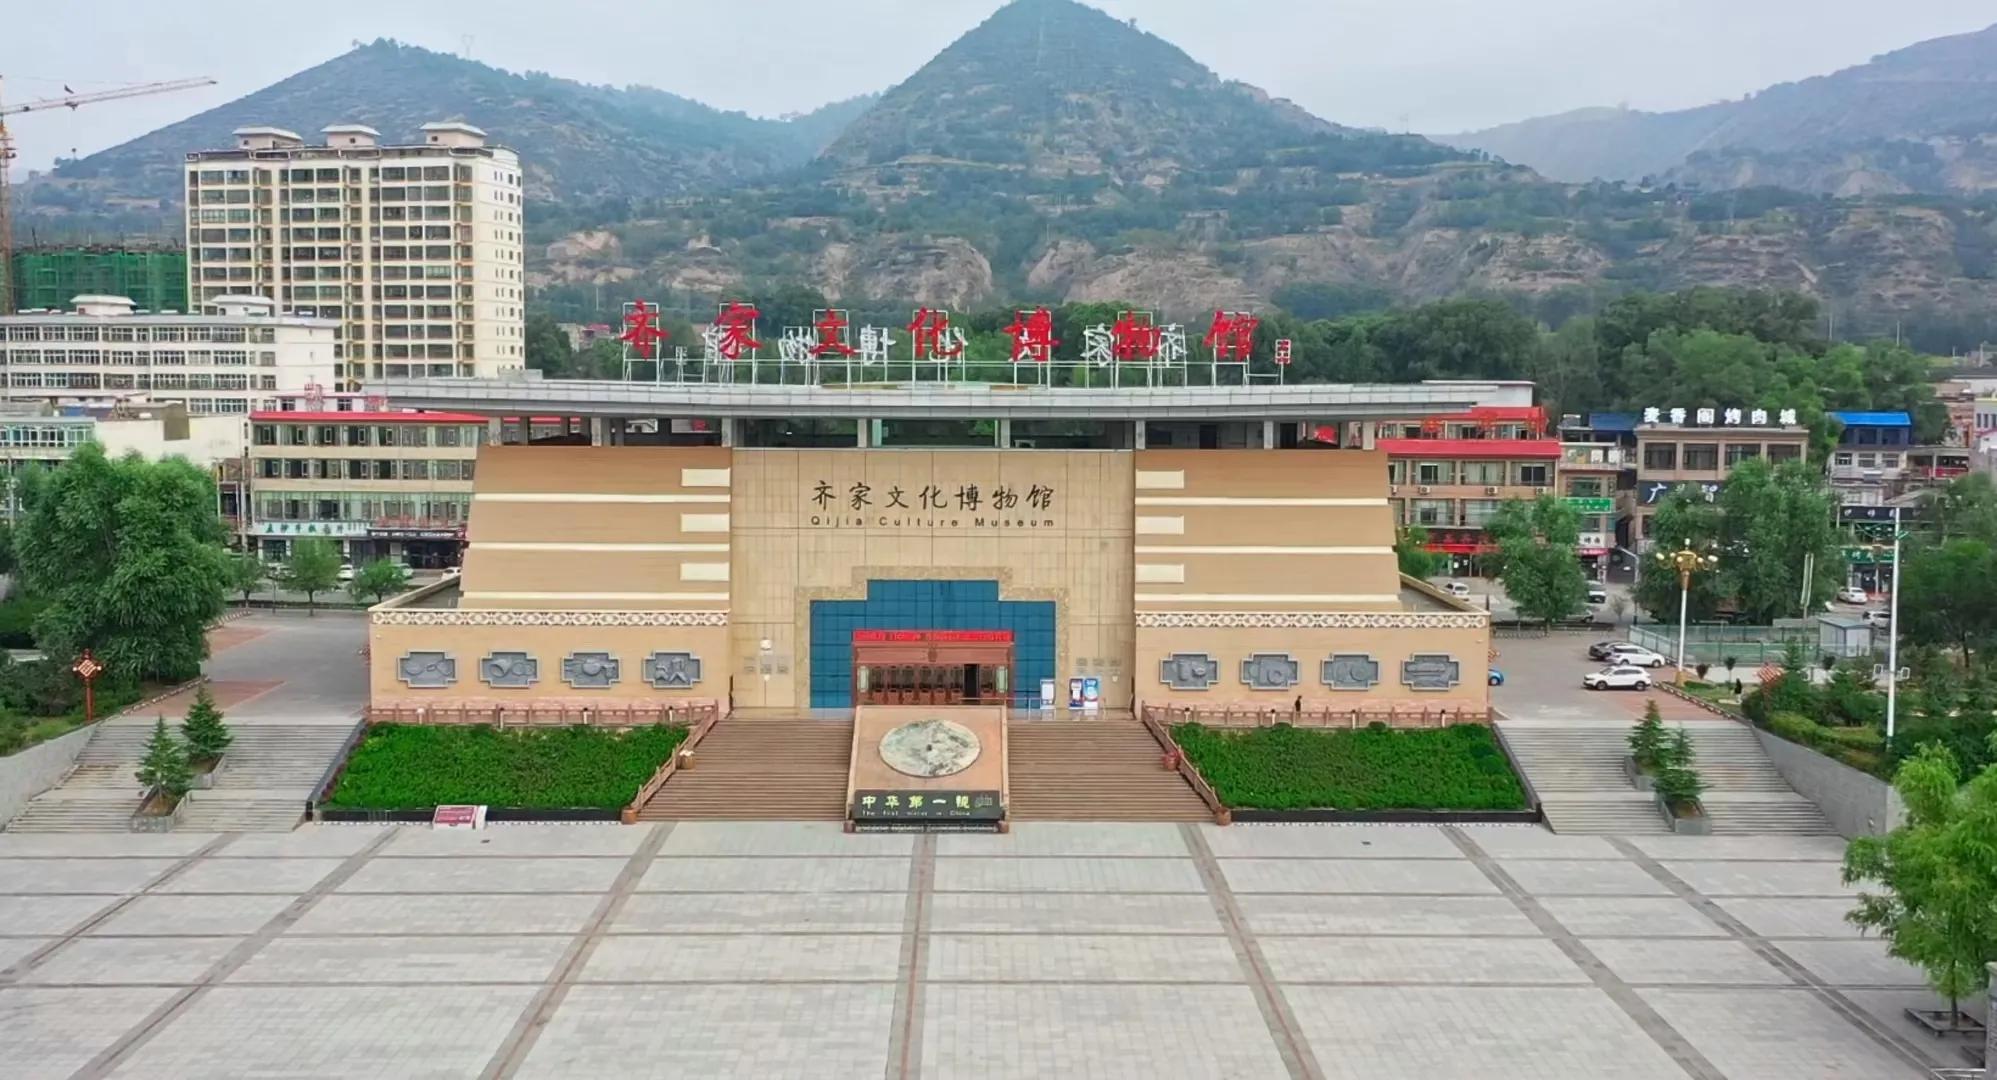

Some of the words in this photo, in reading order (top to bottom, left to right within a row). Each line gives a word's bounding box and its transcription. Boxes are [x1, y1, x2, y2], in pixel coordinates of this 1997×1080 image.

[619, 299, 1258, 362] 齐家文化博物馆
[811, 480, 1055, 511] 齐家文化博物馆
[811, 516, 863, 528] Qijia
[879, 516, 959, 527] Culture
[975, 516, 1055, 527] Museum
